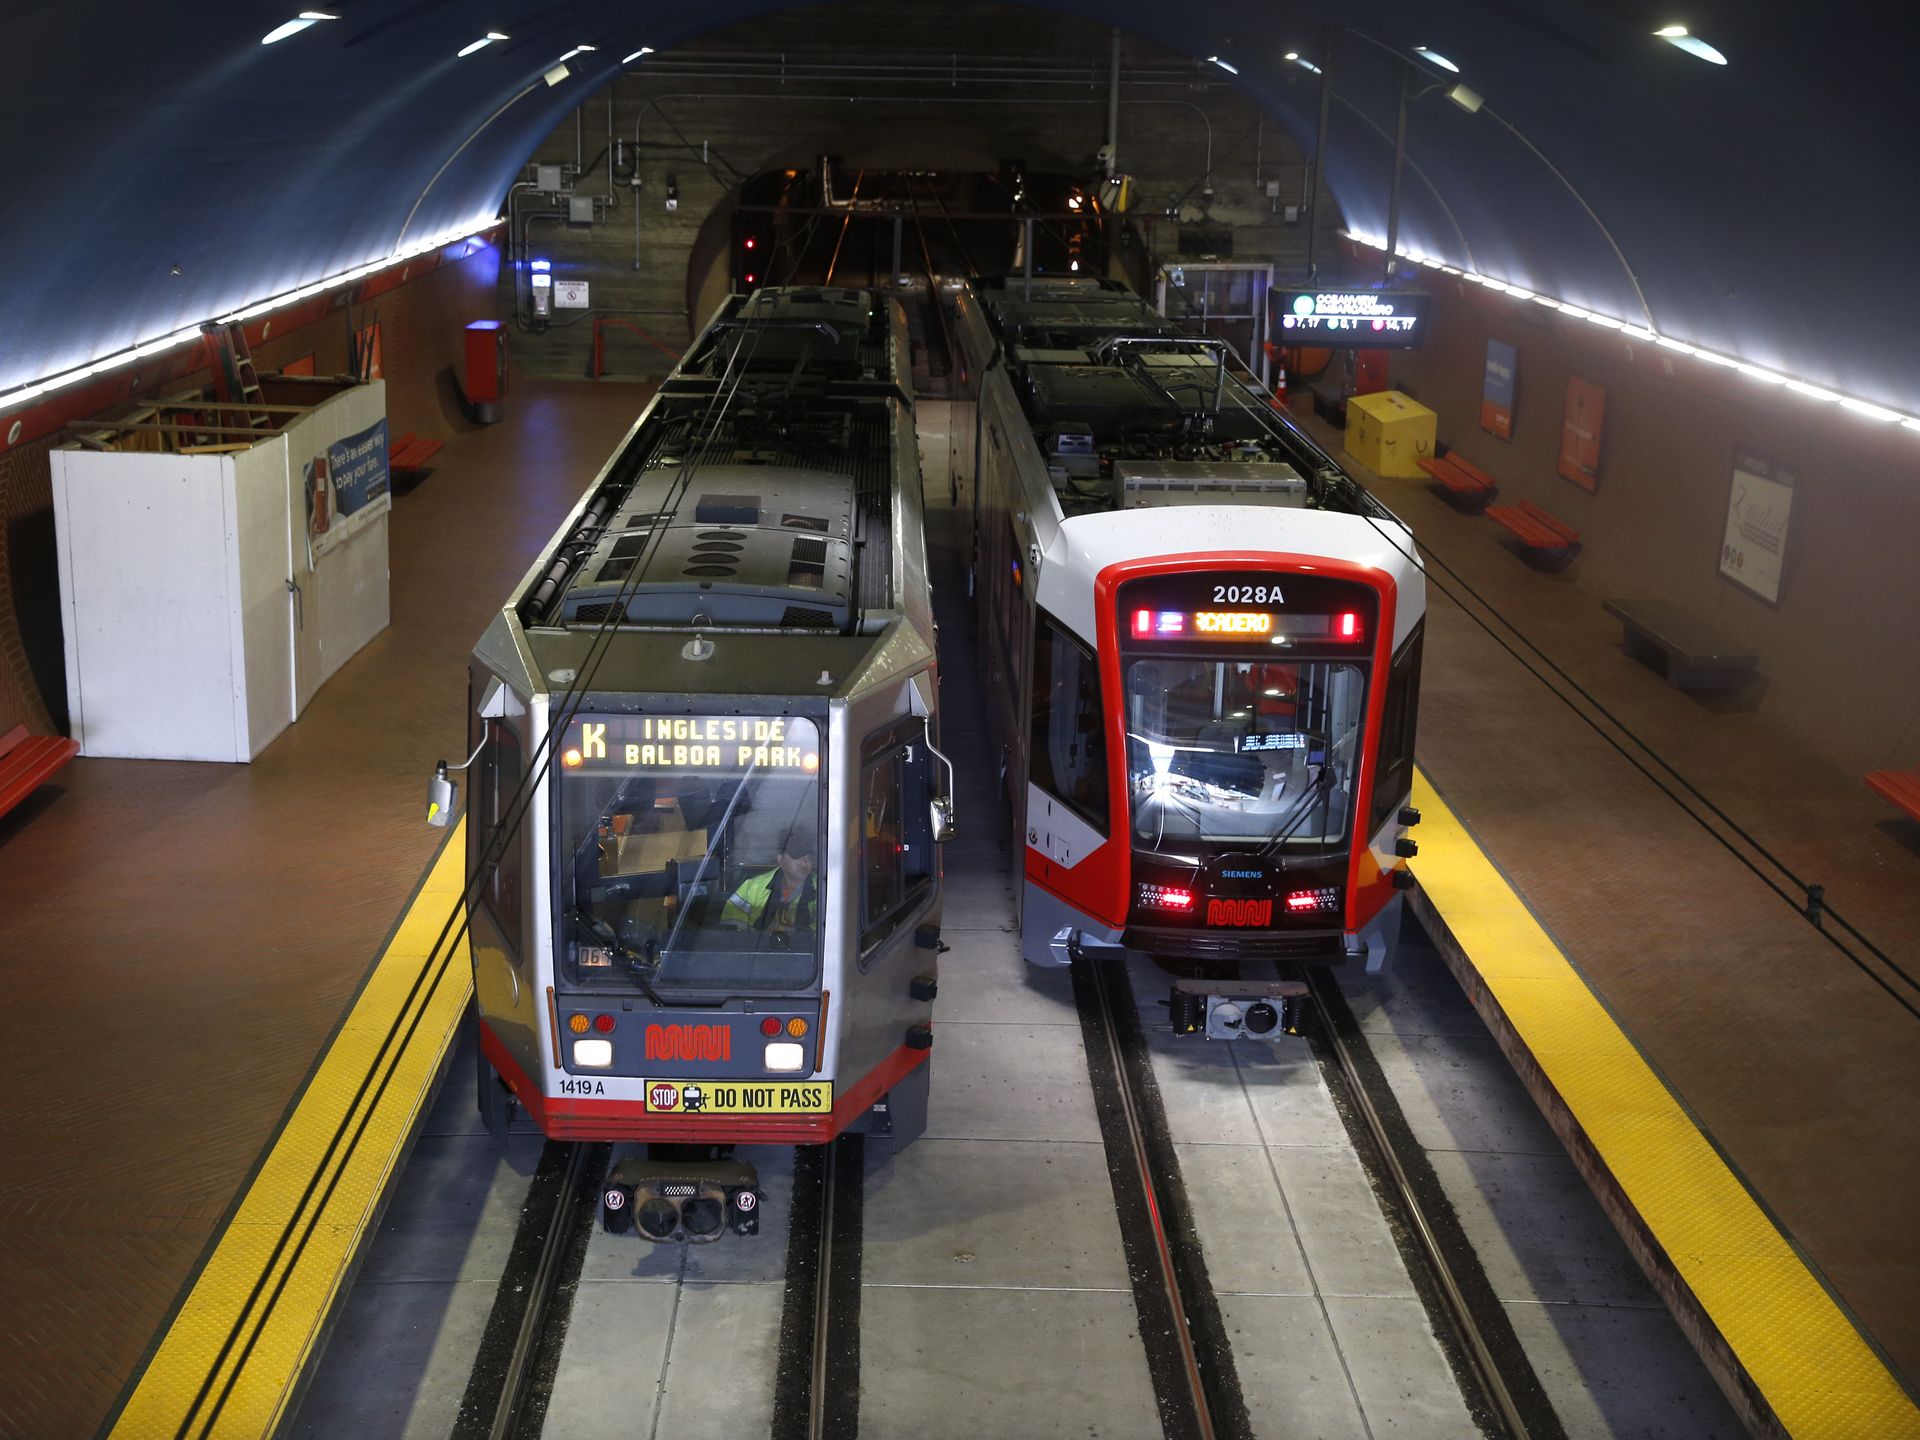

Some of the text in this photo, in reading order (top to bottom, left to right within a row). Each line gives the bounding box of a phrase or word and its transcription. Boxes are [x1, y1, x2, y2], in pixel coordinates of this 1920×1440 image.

[1213, 585, 1285, 604] 2028A
[644, 719, 785, 741] INGLESIDE
[582, 723, 606, 758] K
[625, 744, 801, 767] BALBOA PARK
[1221, 870, 1263, 879] SIEMENS
[559, 1080, 605, 1095] 1419 A
[652, 1089, 677, 1106] STOP
[714, 1088, 737, 1108] DO
[742, 1088, 775, 1108] NOT
[780, 1088, 822, 1108] PASS
